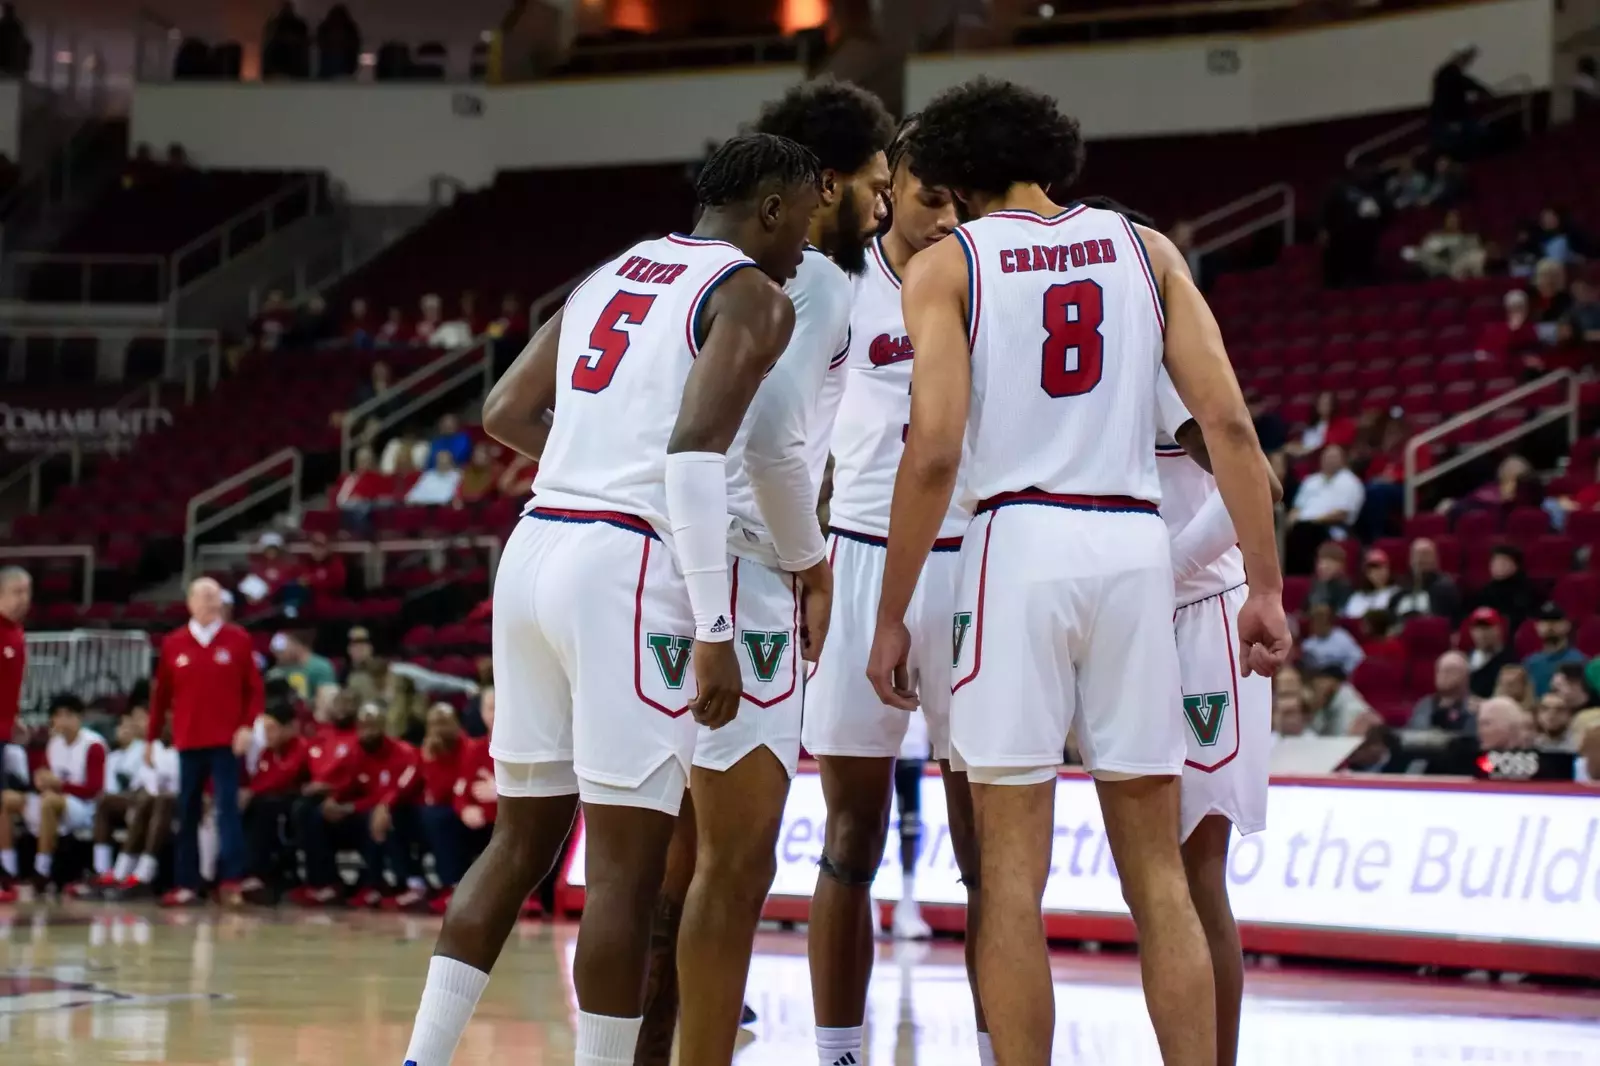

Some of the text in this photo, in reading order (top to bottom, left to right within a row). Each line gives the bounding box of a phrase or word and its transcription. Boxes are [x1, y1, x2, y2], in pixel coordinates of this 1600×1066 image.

[571, 289, 658, 394] 5
[1041, 278, 1104, 398] 8
[647, 632, 694, 689] V
[741, 630, 789, 682] V
[1183, 691, 1229, 747] V
[1284, 809, 1392, 893] the
[1409, 815, 1600, 905] Bulld
